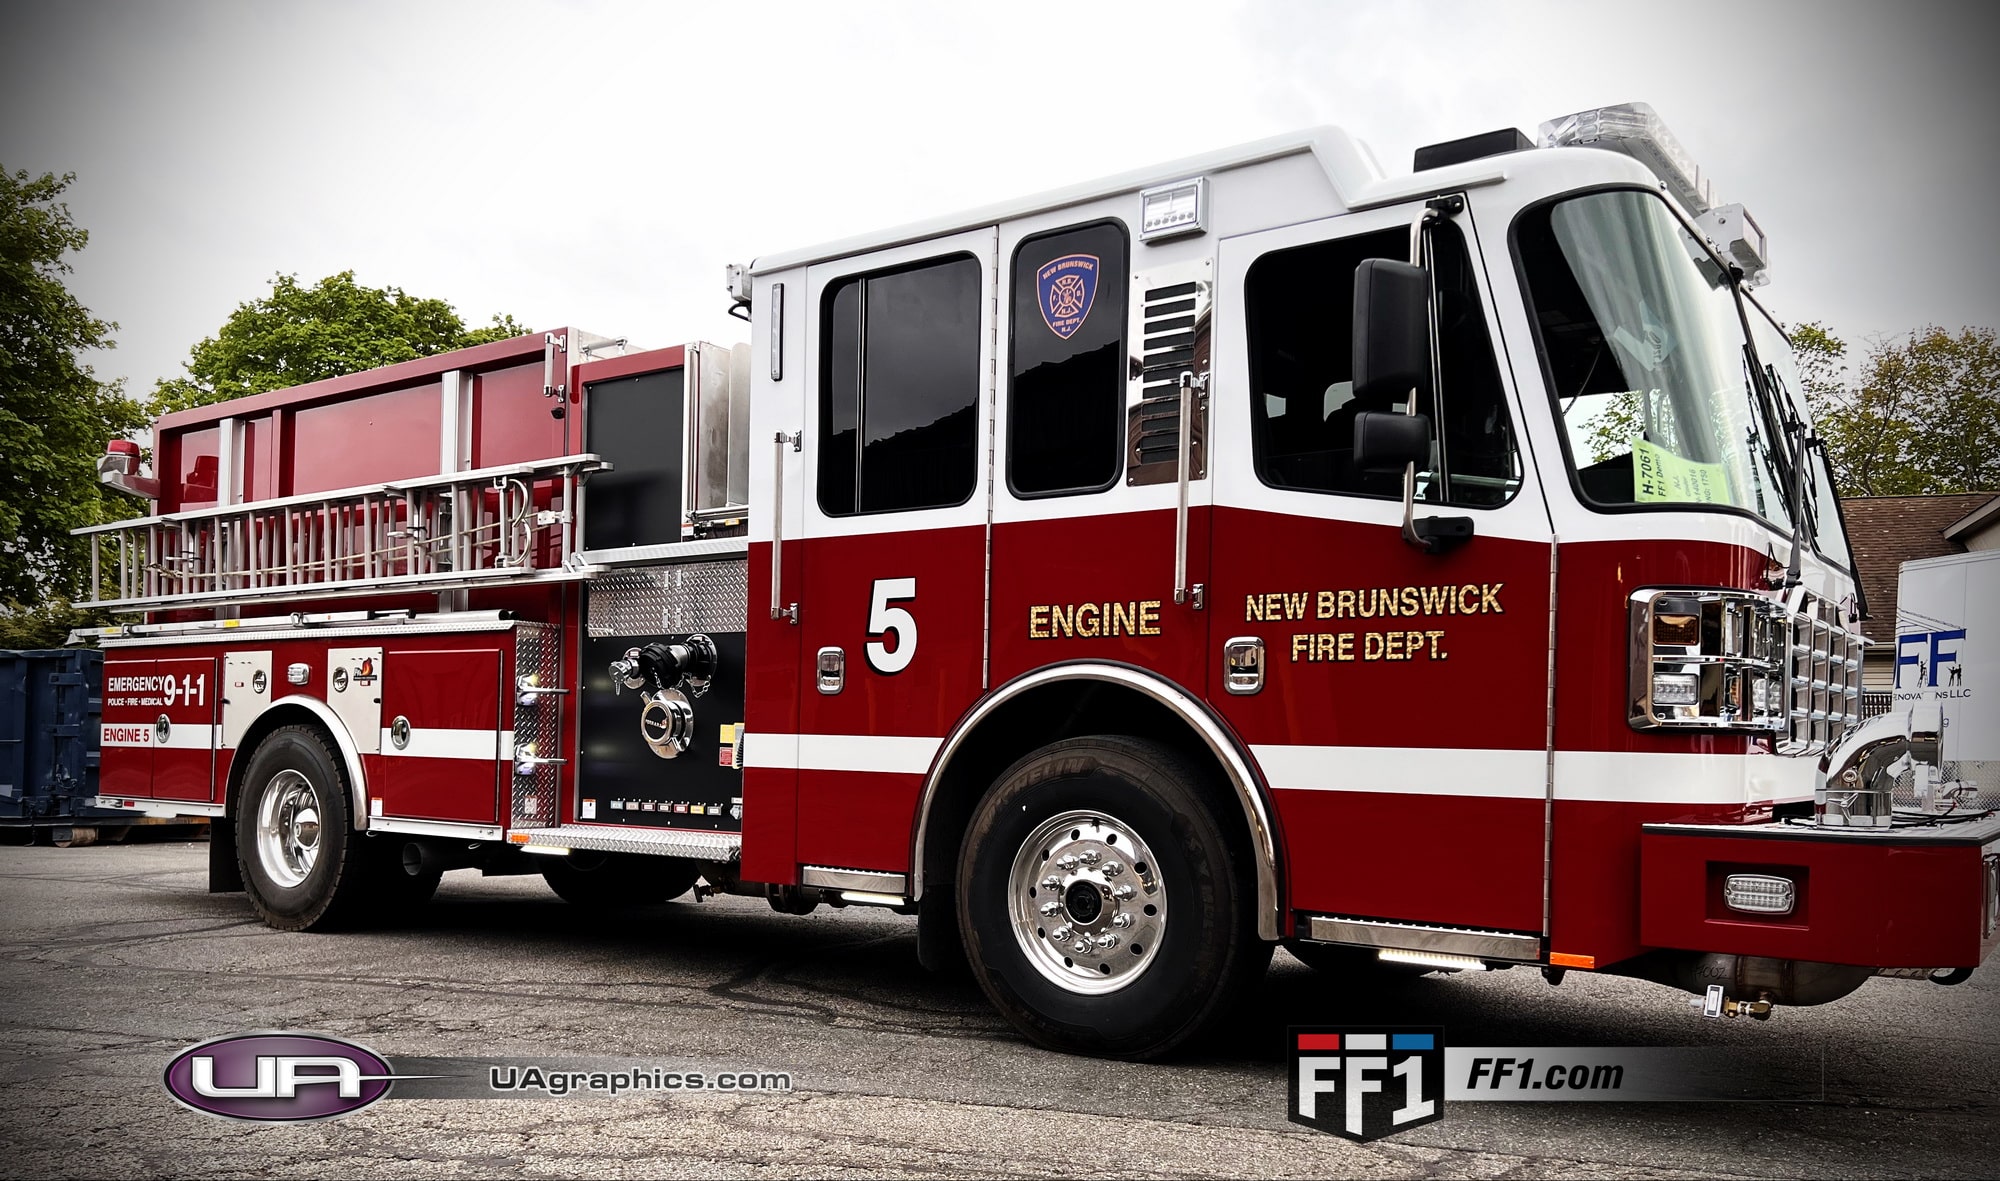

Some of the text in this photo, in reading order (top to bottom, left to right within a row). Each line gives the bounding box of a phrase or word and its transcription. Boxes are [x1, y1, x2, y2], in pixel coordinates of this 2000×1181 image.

[1042, 260, 1094, 279] NEW BRUNSWICK
[1639, 448, 1654, 495] H-7061
[1657, 480, 1666, 497] FF1
[1245, 583, 1505, 622] NEW BRUNSWICK
[863, 577, 918, 677] 5
[1029, 600, 1162, 639] ENGINE
[1292, 630, 1448, 662] FIRE DEPT.
[107, 697, 163, 706] POLICE FIRE MEDICAL
[108, 674, 205, 706] EMERGENCY 9-1-1
[1950, 688, 1972, 699] LLC
[103, 728, 150, 742] ENGINE 5
